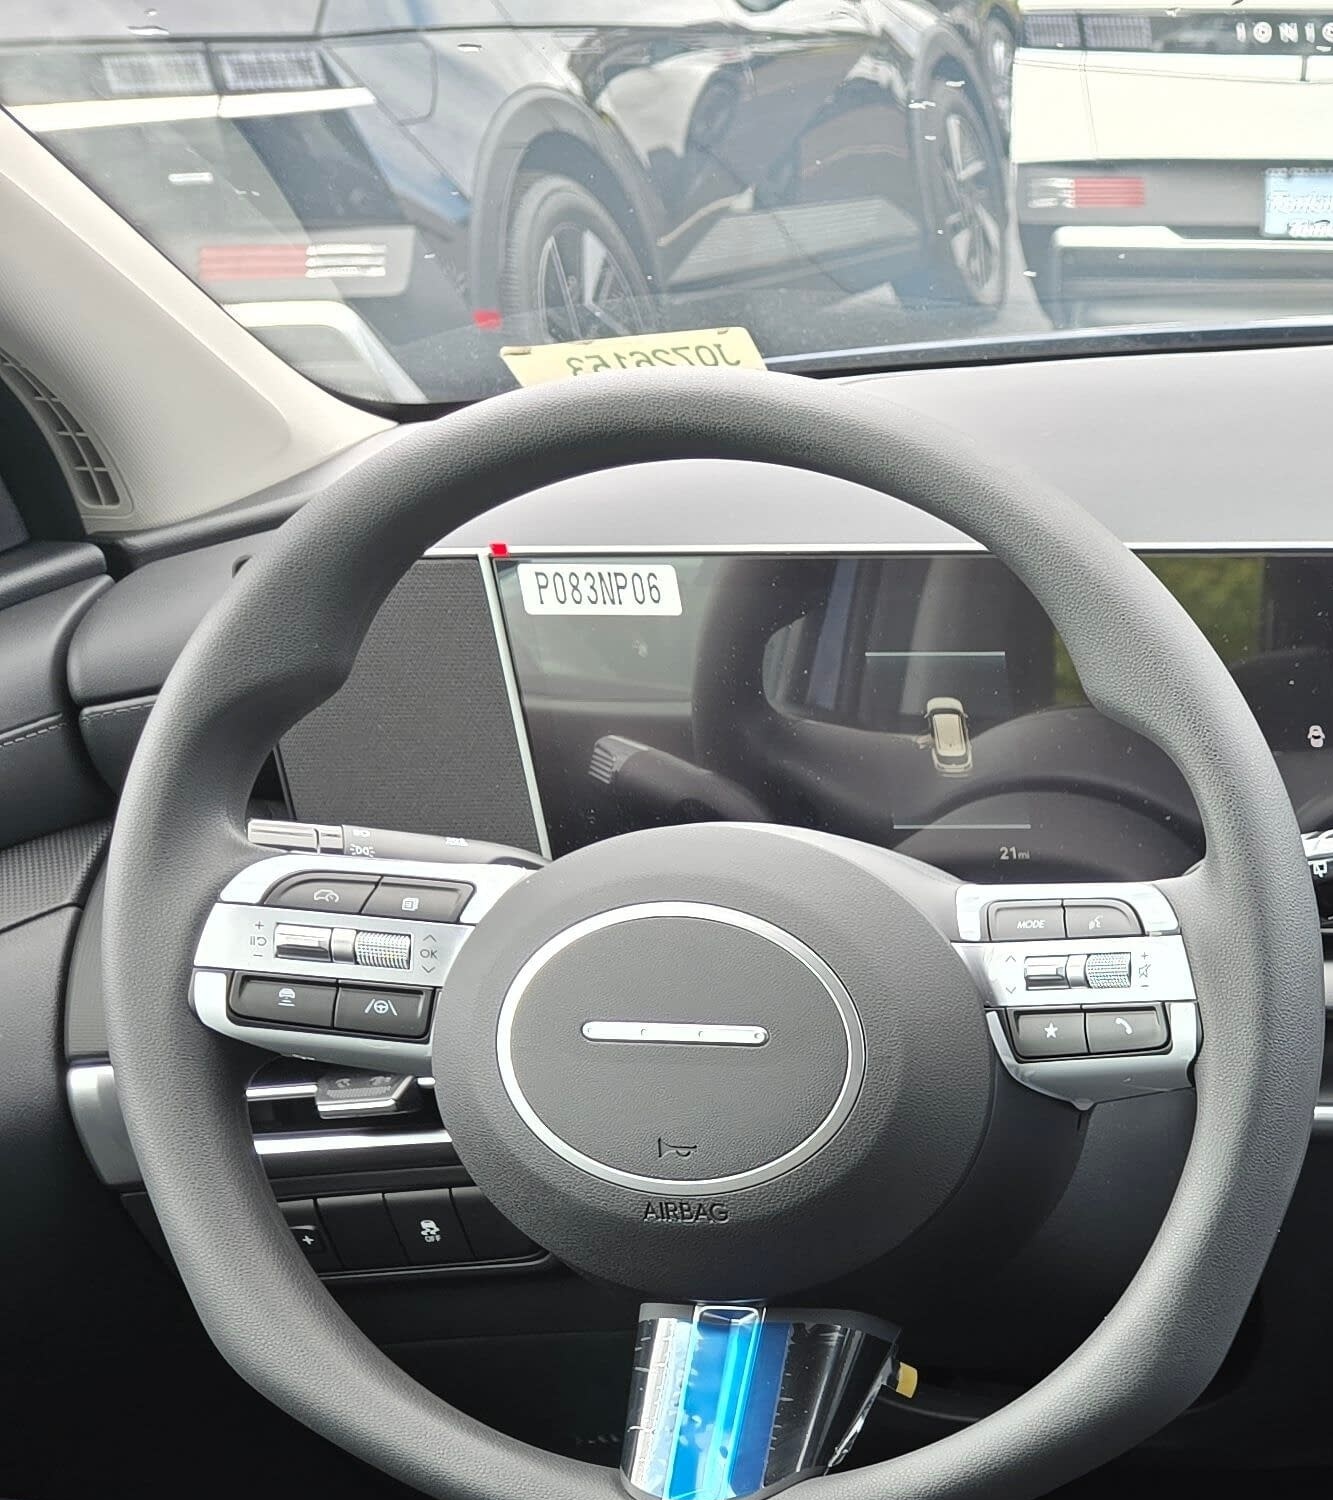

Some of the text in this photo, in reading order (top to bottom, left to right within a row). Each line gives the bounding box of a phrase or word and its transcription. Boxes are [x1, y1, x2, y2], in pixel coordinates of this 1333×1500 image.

[534, 571, 662, 605] P083NP06
[1016, 919, 1046, 929] MODE
[420, 948, 439, 960] OK
[643, 1201, 730, 1224] AIRBAG
